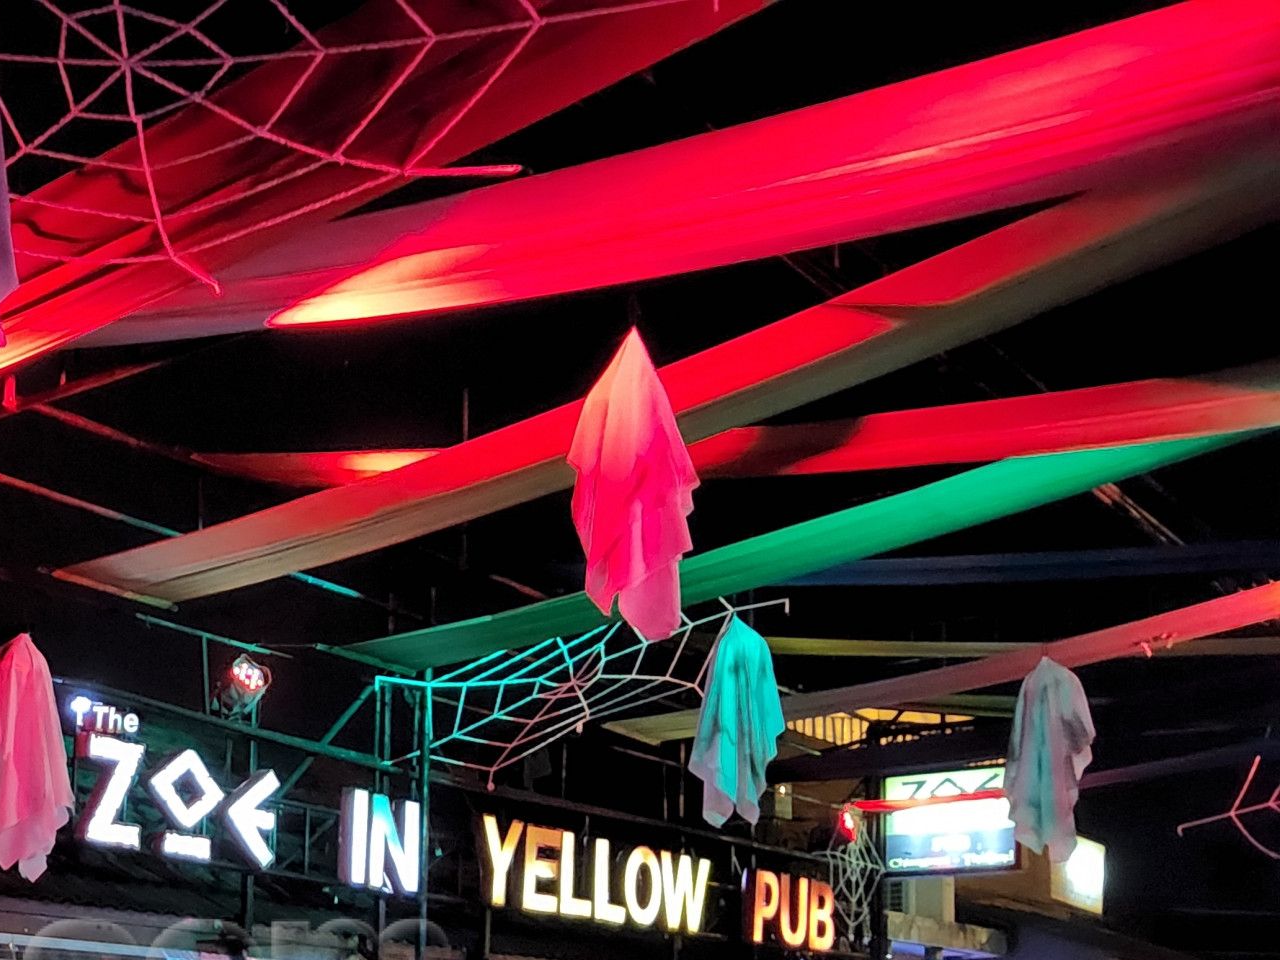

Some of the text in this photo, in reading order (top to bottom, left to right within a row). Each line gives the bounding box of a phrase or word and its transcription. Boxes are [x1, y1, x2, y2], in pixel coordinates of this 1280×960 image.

[92, 705, 140, 733] The
[84, 732, 835, 952] ZOE IN YELLOW PUB
